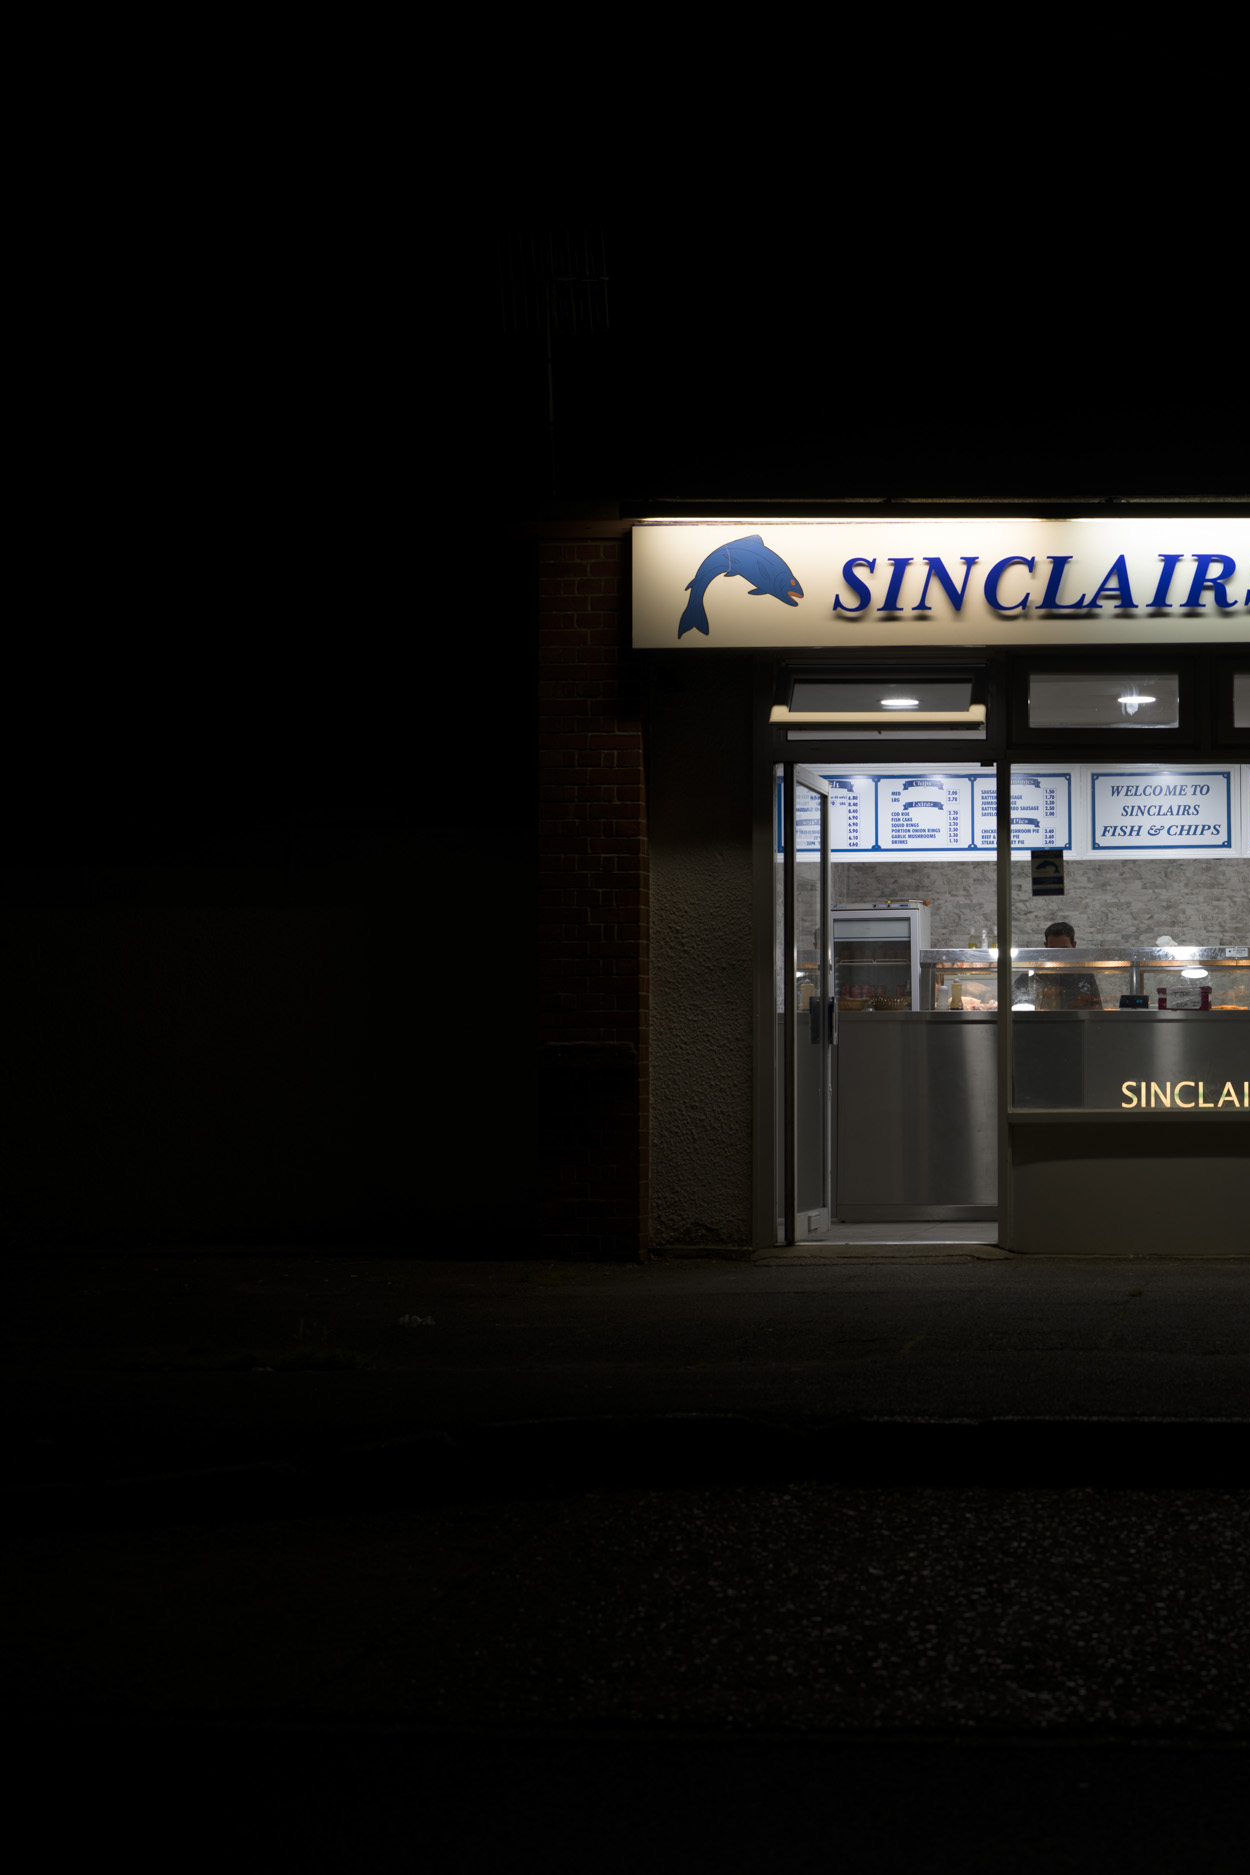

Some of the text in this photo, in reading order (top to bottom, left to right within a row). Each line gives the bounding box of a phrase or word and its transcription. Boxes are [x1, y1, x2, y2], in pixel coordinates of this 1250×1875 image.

[1110, 784, 1210, 797] WELCOME TO
[1121, 804, 1200, 817] SINCLAIRS
[1101, 824, 1221, 837] FISH & CHIPS
